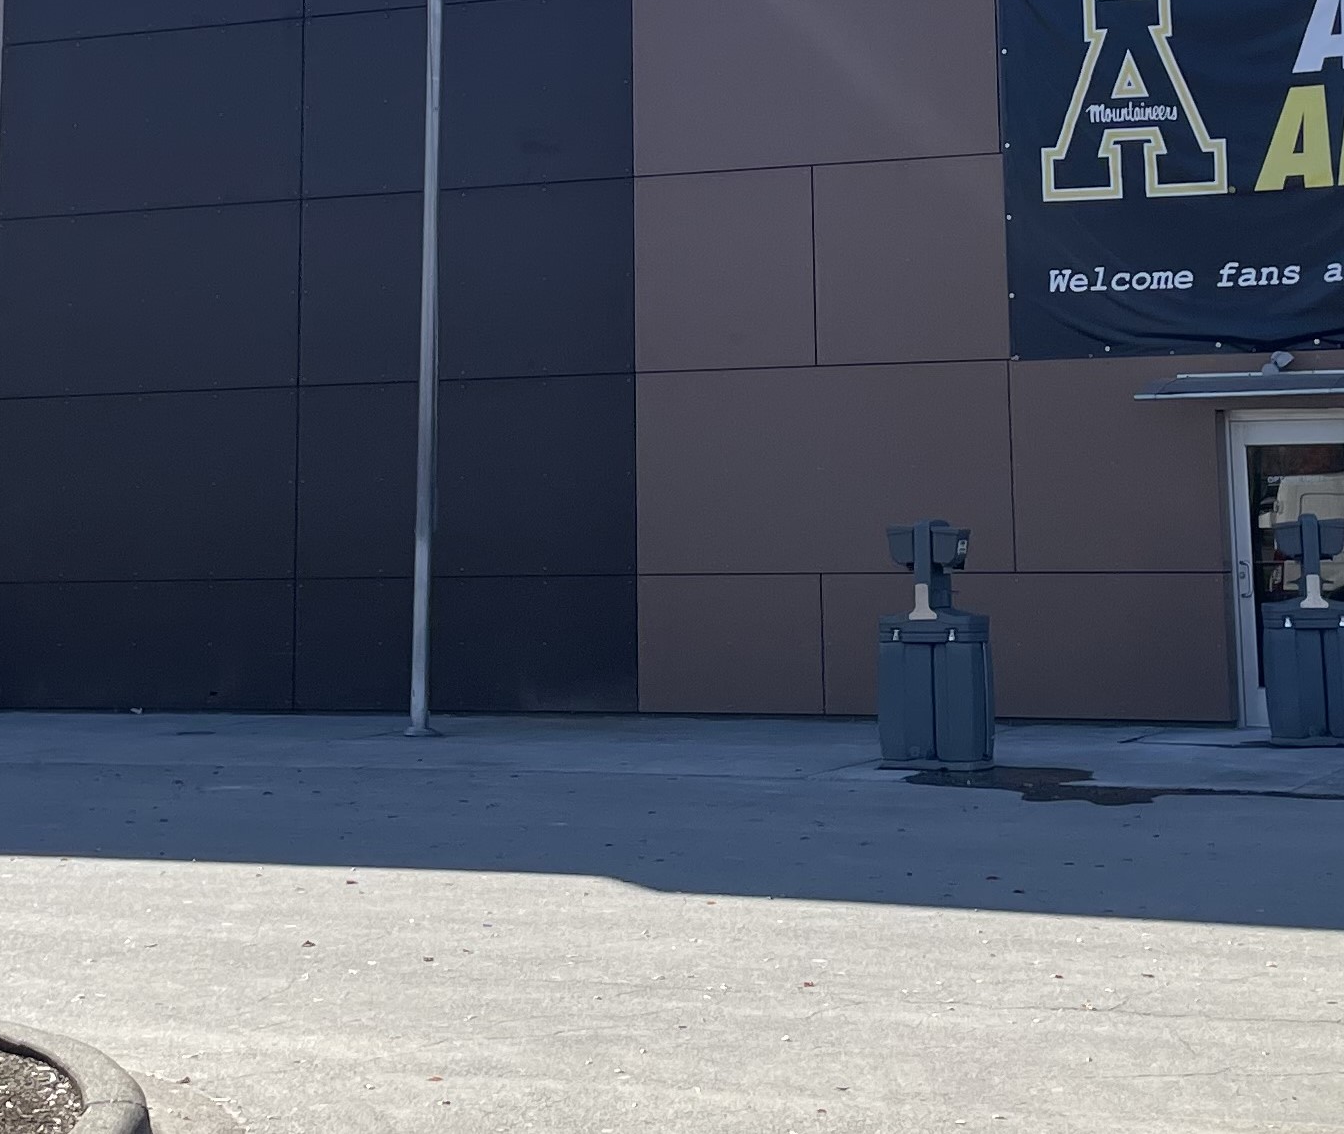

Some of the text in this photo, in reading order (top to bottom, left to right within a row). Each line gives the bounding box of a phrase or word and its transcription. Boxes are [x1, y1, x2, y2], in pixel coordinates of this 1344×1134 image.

[1085, 102, 1178, 123] Mountaineers
[1049, 268, 1194, 293] Welcome
[1216, 263, 1301, 287] fans
